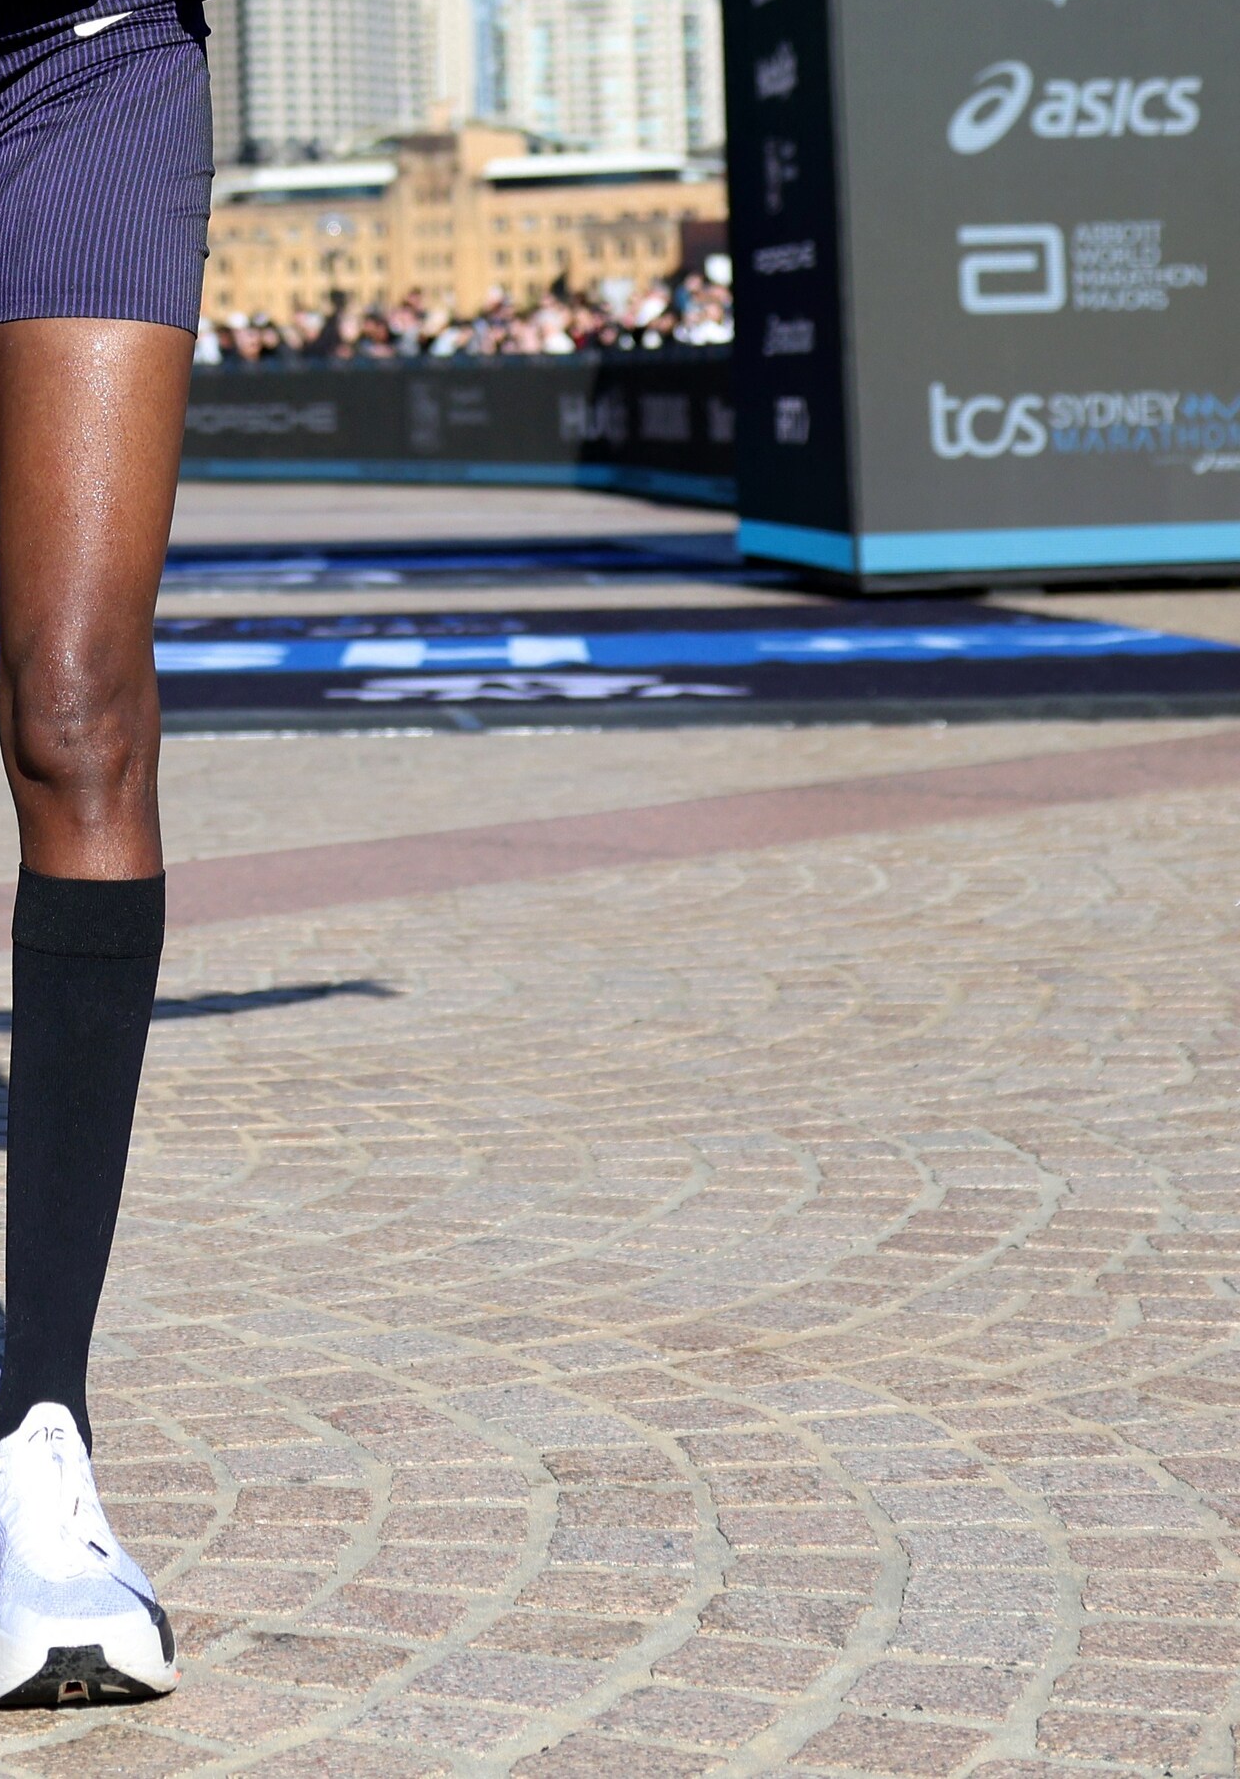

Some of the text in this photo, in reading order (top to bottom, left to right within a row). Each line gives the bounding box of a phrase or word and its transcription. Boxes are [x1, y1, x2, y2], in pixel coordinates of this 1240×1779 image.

[1029, 78, 1202, 138] asics
[929, 381, 1047, 459] tcs
[1048, 390, 1179, 429] SYDNEY
